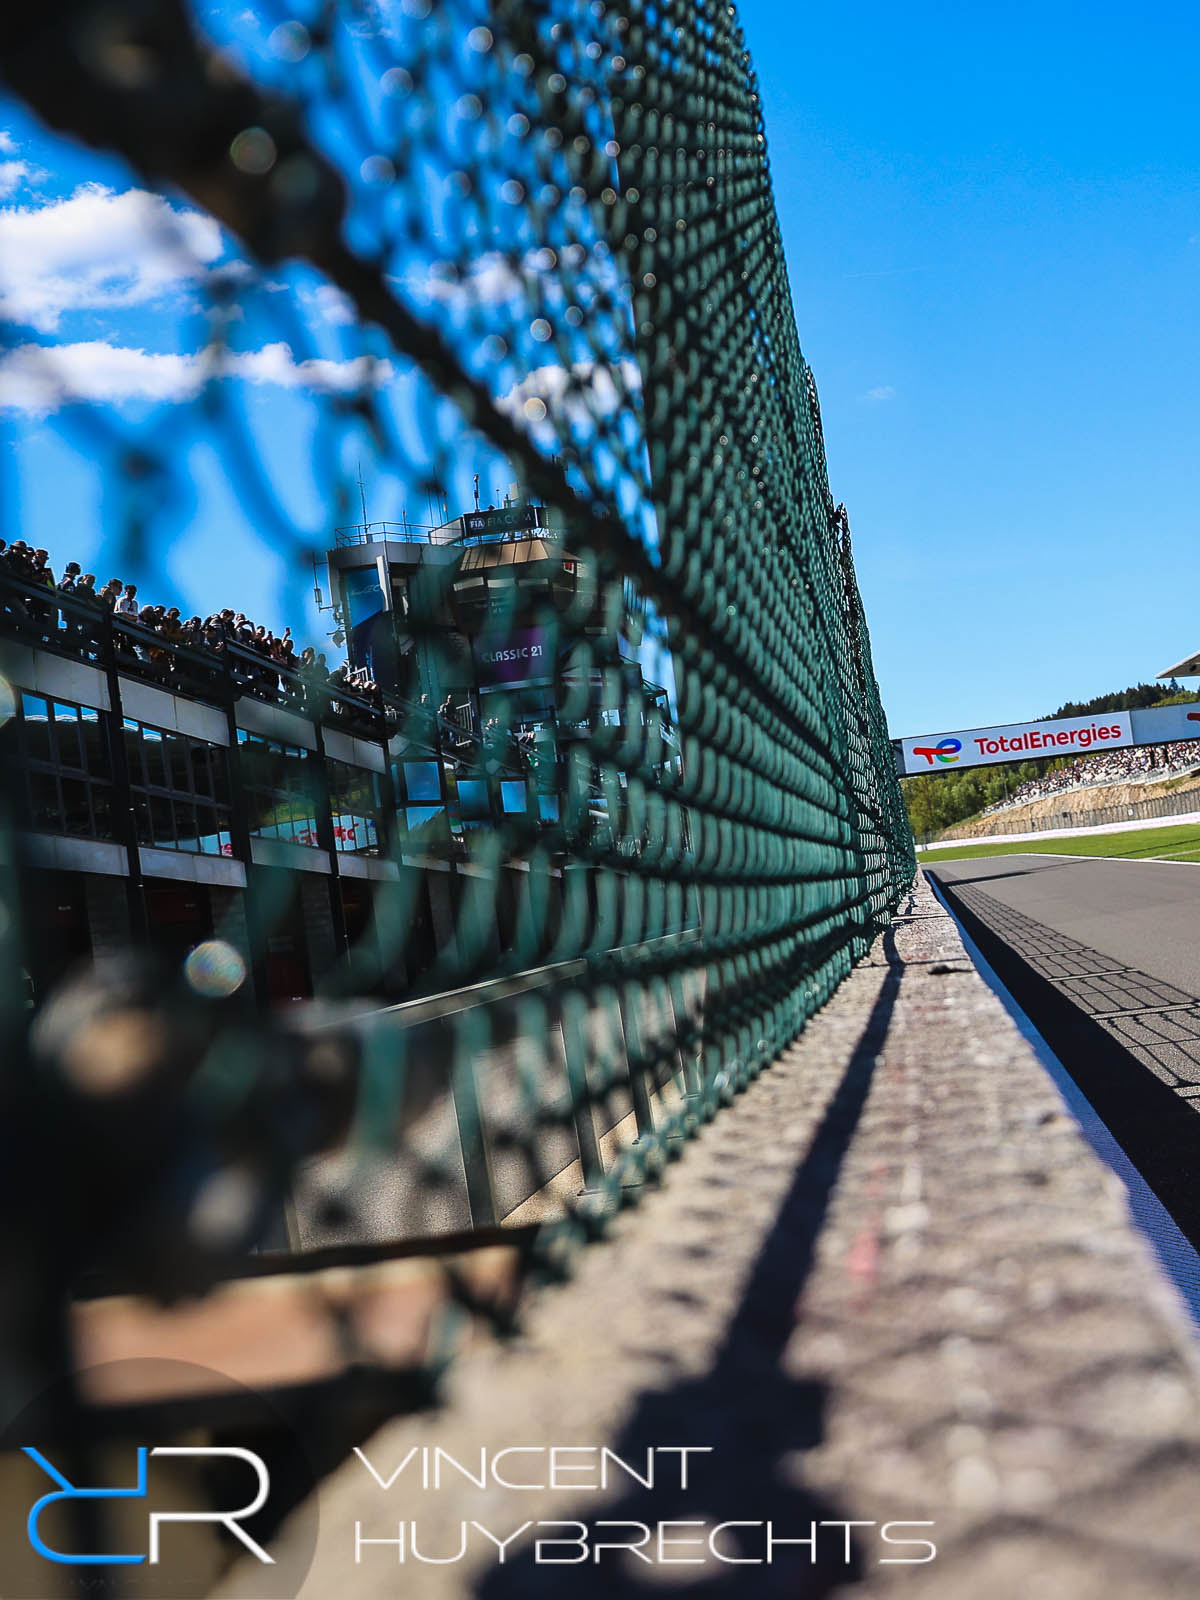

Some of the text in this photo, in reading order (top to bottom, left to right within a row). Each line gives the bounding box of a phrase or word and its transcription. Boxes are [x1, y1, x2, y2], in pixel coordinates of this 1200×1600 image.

[482, 645, 542, 662] CLASSIC 21
[974, 723, 1122, 755] TotalEnergies
